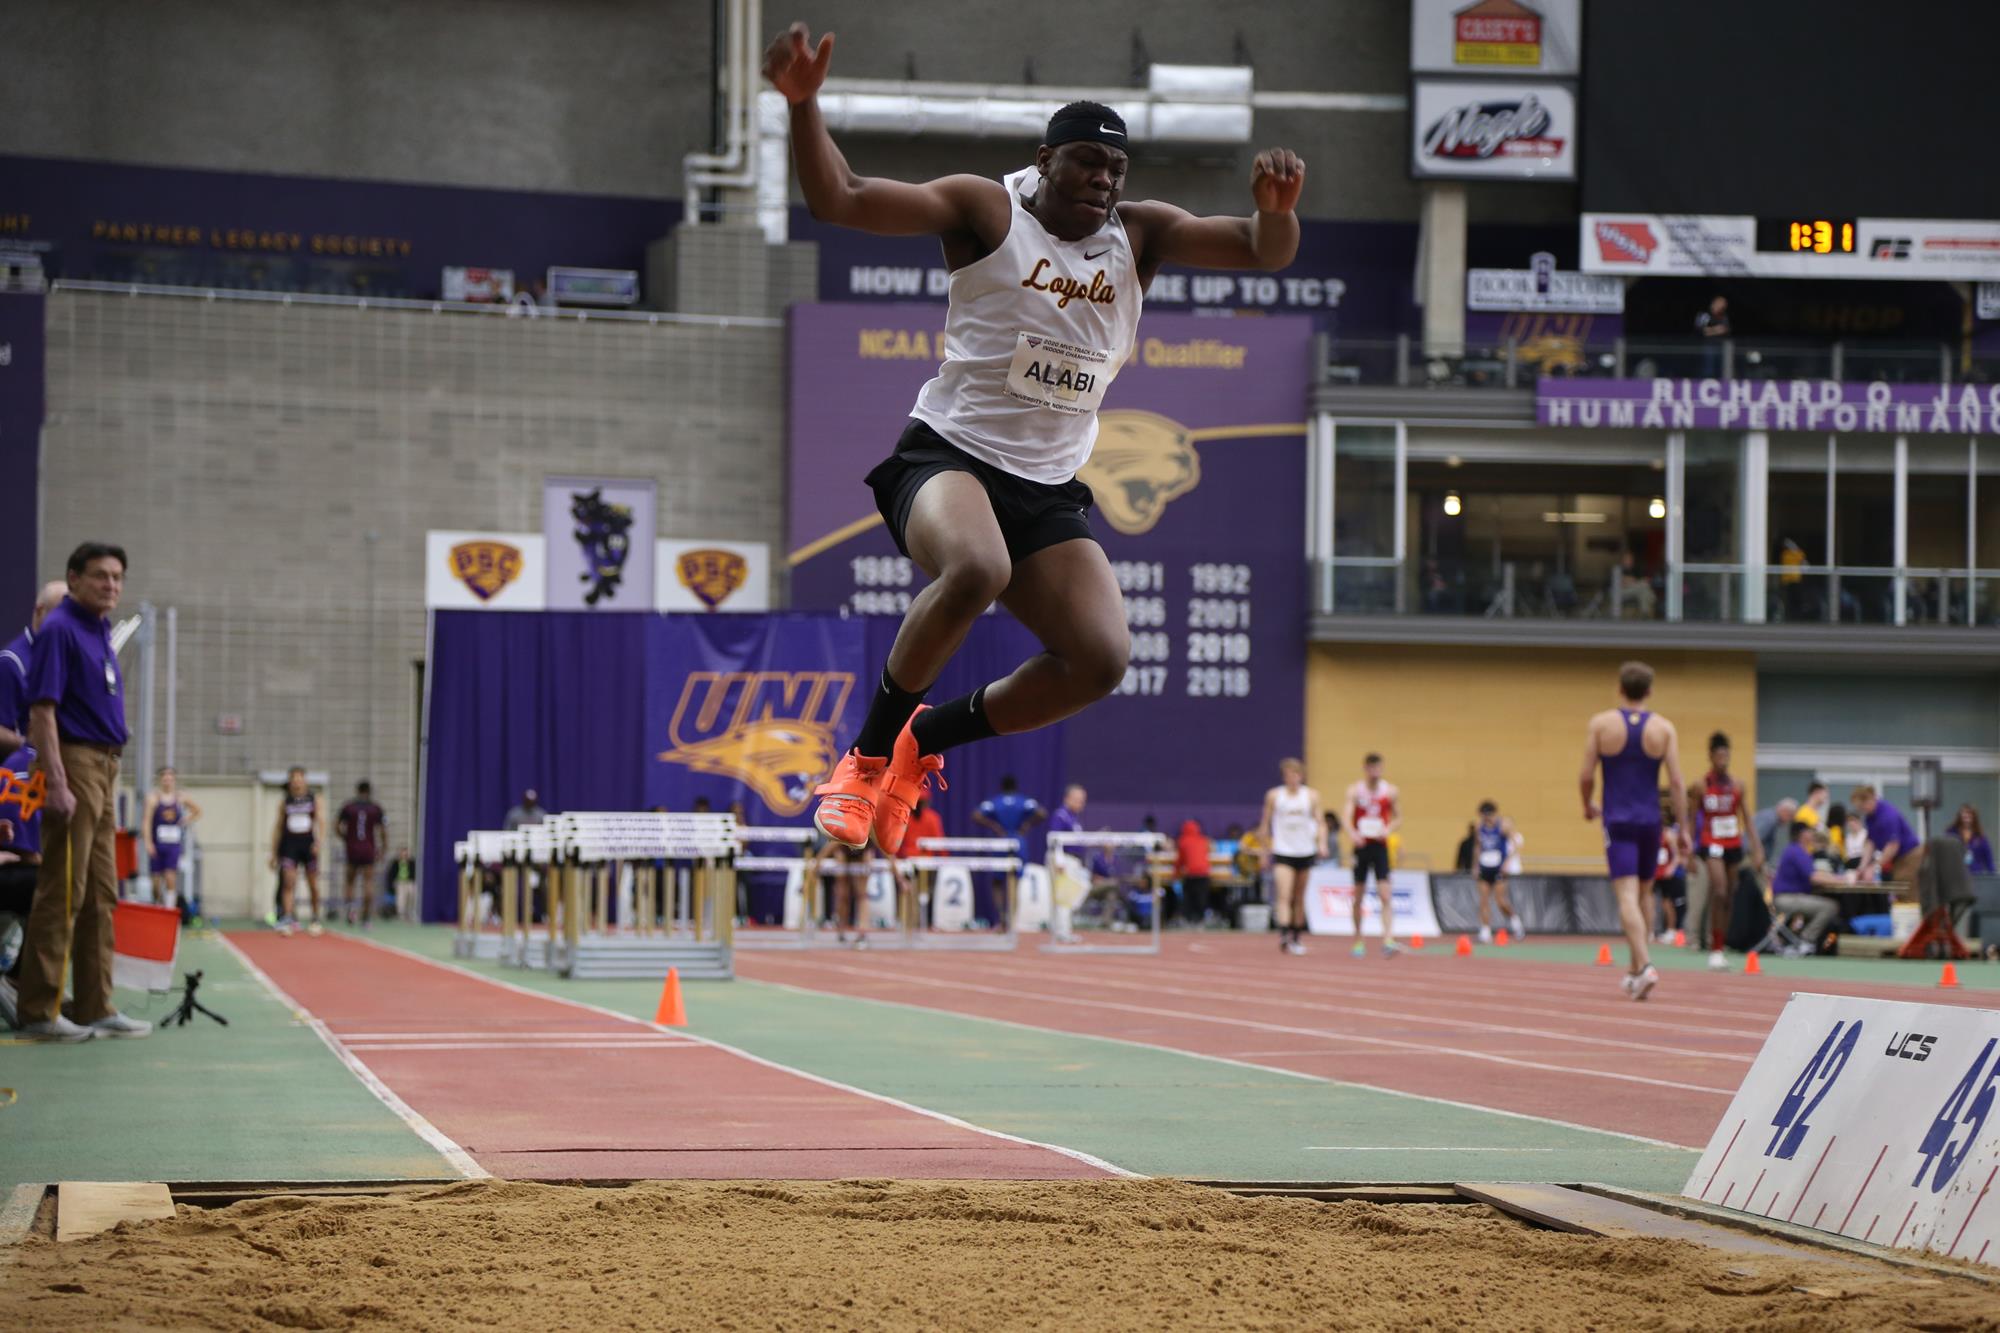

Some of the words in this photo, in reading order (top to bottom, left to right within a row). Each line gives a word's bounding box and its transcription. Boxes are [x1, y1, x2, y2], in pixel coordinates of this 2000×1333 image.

[1460, 18, 1536, 41] CASEY'S
[93, 219, 202, 246] PANTHER
[210, 227, 303, 250] LEGACY
[310, 233, 412, 257] SOCIETY
[1790, 221, 1853, 254] 1:31
[850, 265, 923, 295] HOW
[1021, 257, 1117, 309] Loyola
[1191, 275, 1236, 304] UP
[1239, 276, 1279, 305] TO
[1284, 278, 1347, 308] TC?
[858, 329, 930, 360] NCAA
[1143, 337, 1247, 369] Qualifier
[1042, 345, 1066, 355] INDOOR
[1043, 338, 1060, 348] 2020
[1059, 343, 1074, 352] MVC
[1074, 346, 1091, 357] TRACK
[1023, 361, 1096, 394] ALABI
[1652, 377, 1843, 410] RICHARD
[1010, 391, 1043, 404] UNIVERSITY
[1052, 402, 1079, 413] NORTHERN
[1549, 399, 1695, 428] HUMAN
[1189, 562, 1251, 594] 1992
[1188, 597, 1251, 630] 2001
[1188, 632, 1251, 663] 2010
[1111, 665, 1168, 696] 017
[1187, 666, 1251, 697] 2018
[668, 671, 856, 749] UNI
[942, 877, 964, 906] 2
[1884, 1031, 1939, 1062] UCS
[1763, 1018, 1864, 1161] 42
[1911, 1037, 2000, 1194] 45
